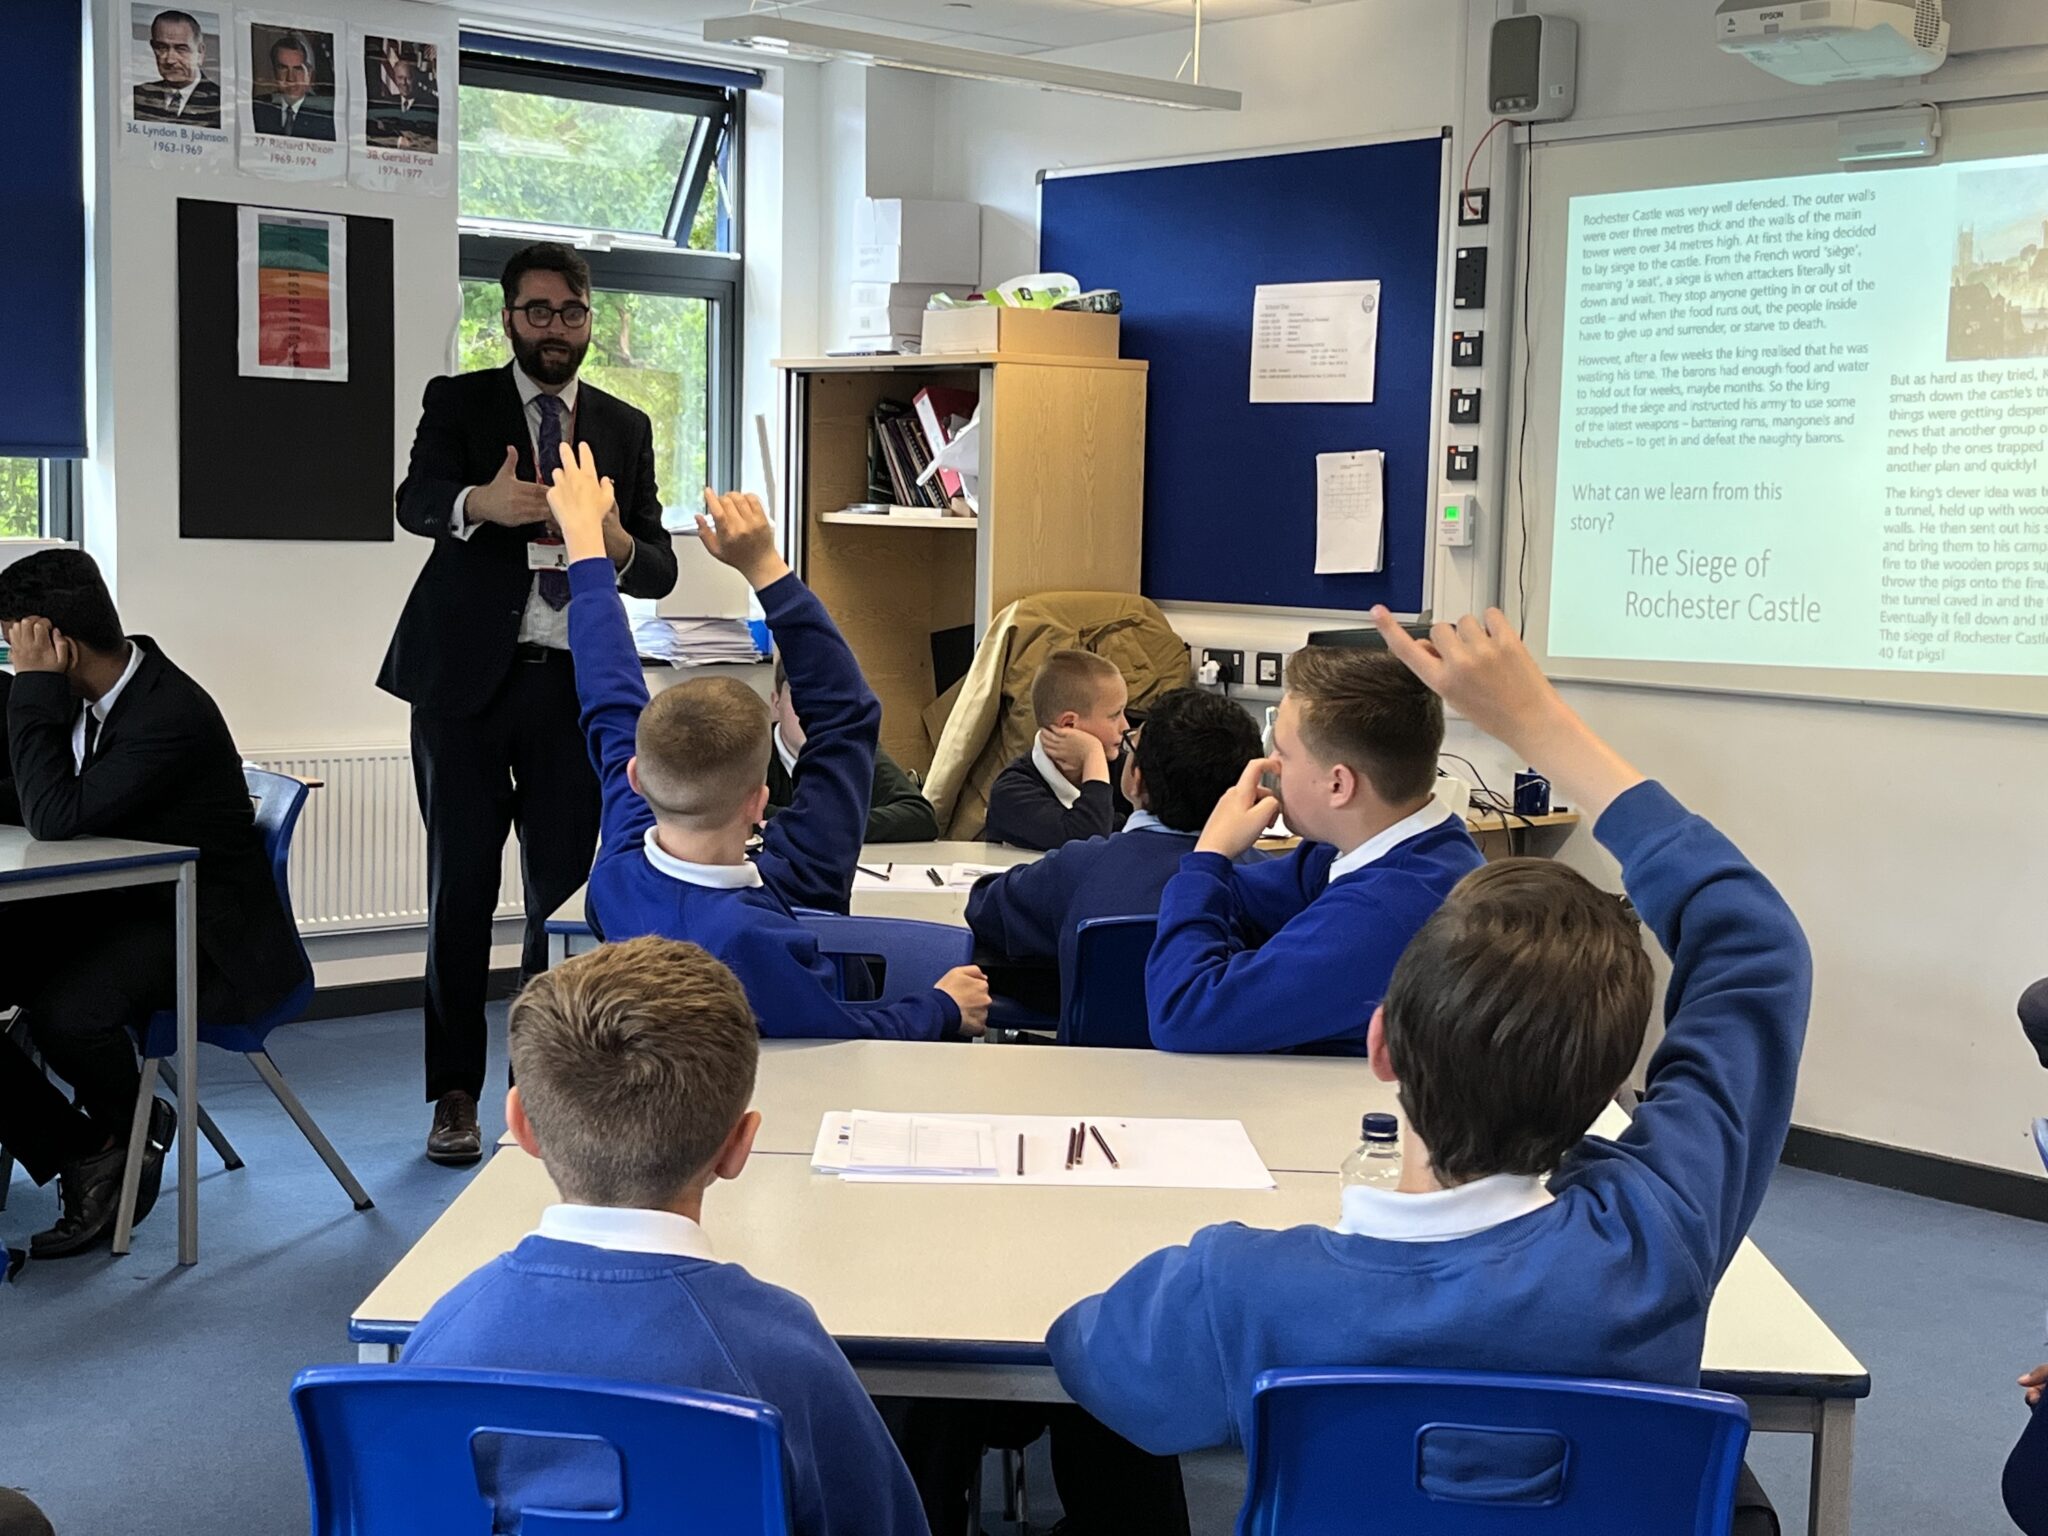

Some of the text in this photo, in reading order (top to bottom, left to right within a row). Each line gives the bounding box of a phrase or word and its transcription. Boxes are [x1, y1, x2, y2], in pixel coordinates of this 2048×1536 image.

[1760, 12, 1784, 21] EPSON
[142, 125, 177, 139] Lyndon
[190, 130, 228, 145] Johnson
[269, 138, 303, 151] Richard
[306, 142, 334, 154] Nixon
[153, 140, 202, 155] 1963-1969
[381, 152, 410, 163] Gerald
[413, 154, 433, 166] Ford
[1583, 188, 1876, 226] Rochester Castle very well defended. outer walls
[1582, 210, 1861, 242] were over three metres thick walls main
[1582, 224, 1876, 258] tower were over metres high. first king decided
[1610, 245, 1820, 275] siege castle. From French word
[1580, 262, 1835, 294] meaning siege when attackers literally
[1580, 296, 1607, 308] down
[1658, 290, 1682, 304] They
[1684, 289, 1707, 302] stop
[1709, 288, 1747, 301] anyone
[1750, 284, 1788, 300] getting
[1579, 312, 1606, 324] castle
[1638, 308, 1666, 320] when
[1688, 304, 1713, 317] food
[1715, 305, 1738, 316] runs
[1785, 299, 1822, 315] people
[1825, 297, 1857, 310] inside
[1579, 329, 1601, 341] have
[1616, 327, 1637, 341] give
[1743, 321, 1775, 332] starve
[1792, 316, 1826, 330] death.
[1578, 343, 1826, 366] However, after weeks king realised that
[1577, 360, 1869, 384] wasting barons enough food water
[1589, 386, 1611, 398] hold
[1686, 382, 1720, 396] maybe
[1806, 378, 1830, 393] king
[1575, 398, 1856, 416] scrapped siege instructed army some
[1606, 420, 1632, 430] latest
[1635, 419, 1679, 430] weapons
[1690, 416, 1738, 430] battering
[1771, 416, 1830, 429] mangonels
[1574, 432, 1844, 448] trebuchets defeat naughty barons.
[1572, 481, 1782, 500] What can we learn from this
[1570, 512, 1614, 532] story?
[1628, 548, 1771, 583] The Siege of
[1625, 590, 1820, 622] Rochester Castle
